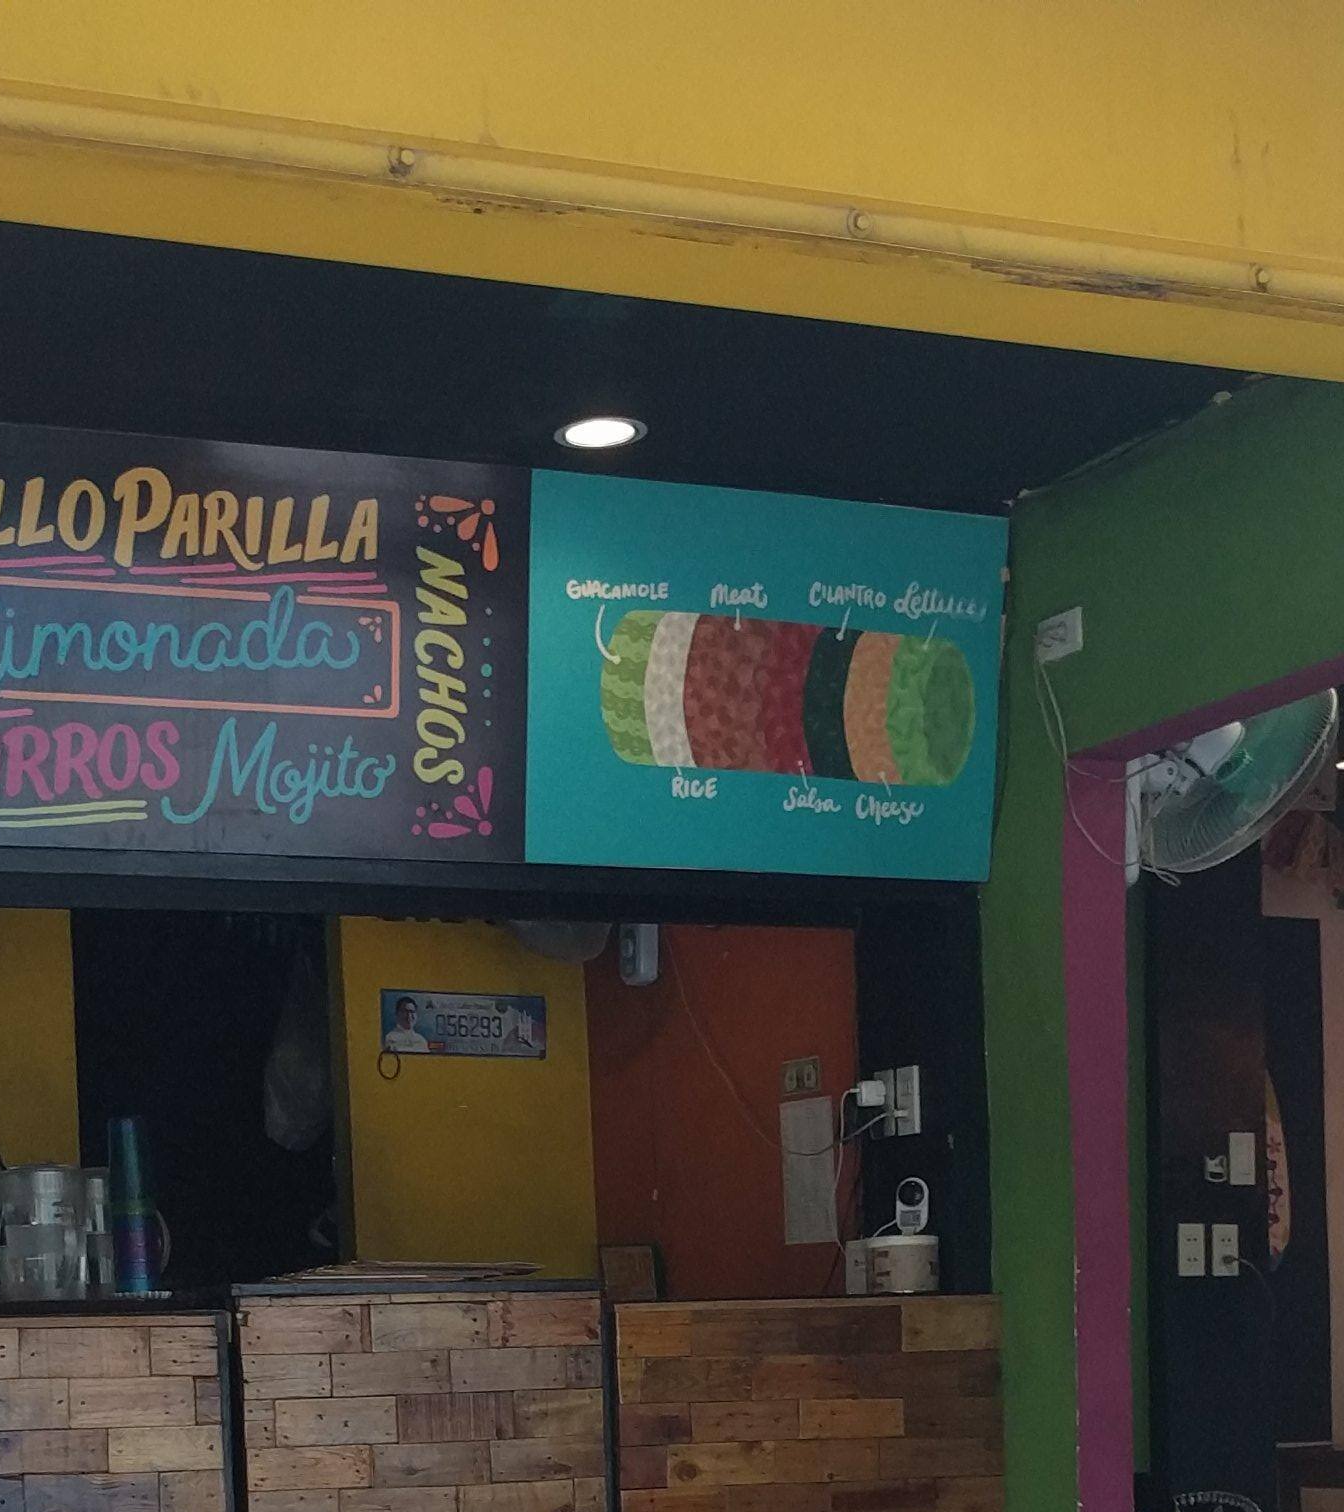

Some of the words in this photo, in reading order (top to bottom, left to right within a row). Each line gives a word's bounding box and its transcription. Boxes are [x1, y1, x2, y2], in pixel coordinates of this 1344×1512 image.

[113, 466, 379, 571] PARILLA
[566, 579, 669, 600] GUACAMOLE
[413, 545, 468, 785] NACHOS
[161, 716, 398, 825] Mojito
[672, 776, 718, 799] RICE
[783, 787, 841, 812] Salsa
